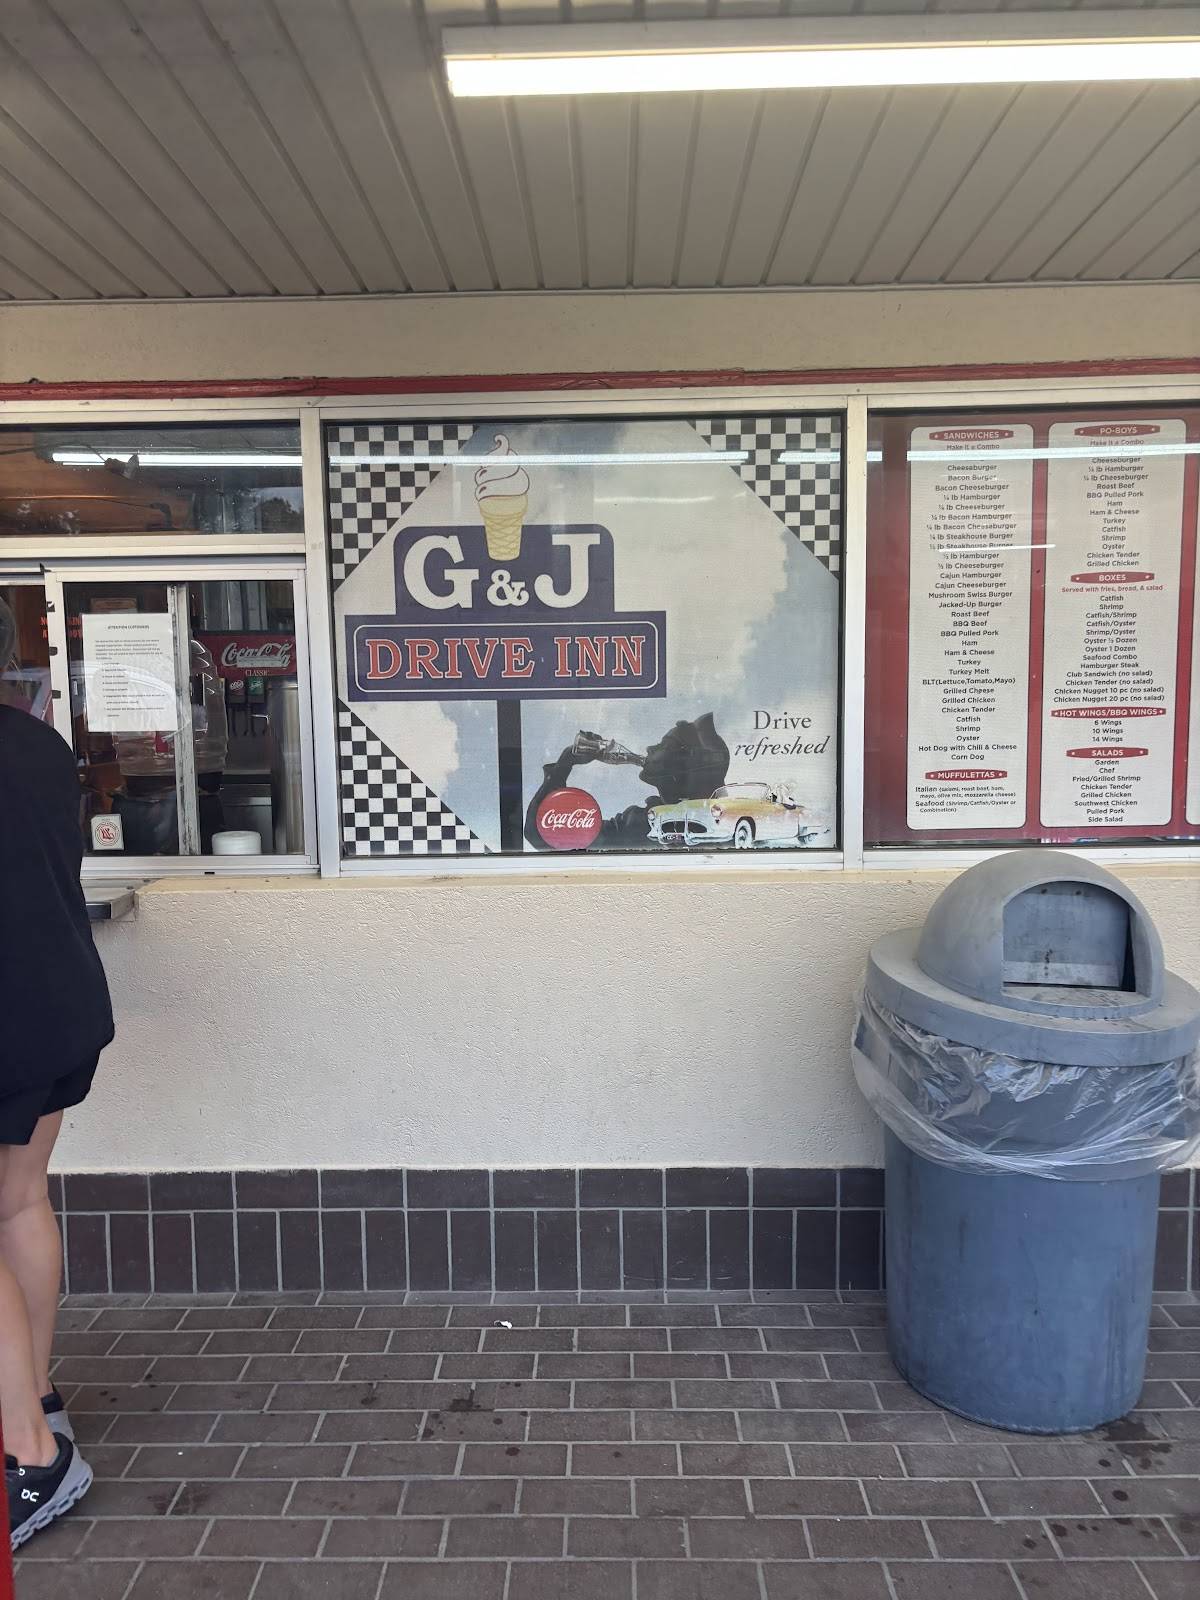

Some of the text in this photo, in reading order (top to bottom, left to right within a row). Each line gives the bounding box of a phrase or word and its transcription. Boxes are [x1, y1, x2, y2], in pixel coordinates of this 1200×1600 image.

[366, 636, 645, 680] DRIVE INN
[753, 710, 812, 730] Drive
[1060, 709, 1076, 717] HOT
[1130, 708, 1157, 716] WINGS
[734, 735, 830, 762] refreshed
[541, 808, 598, 831] Coca-Cola
